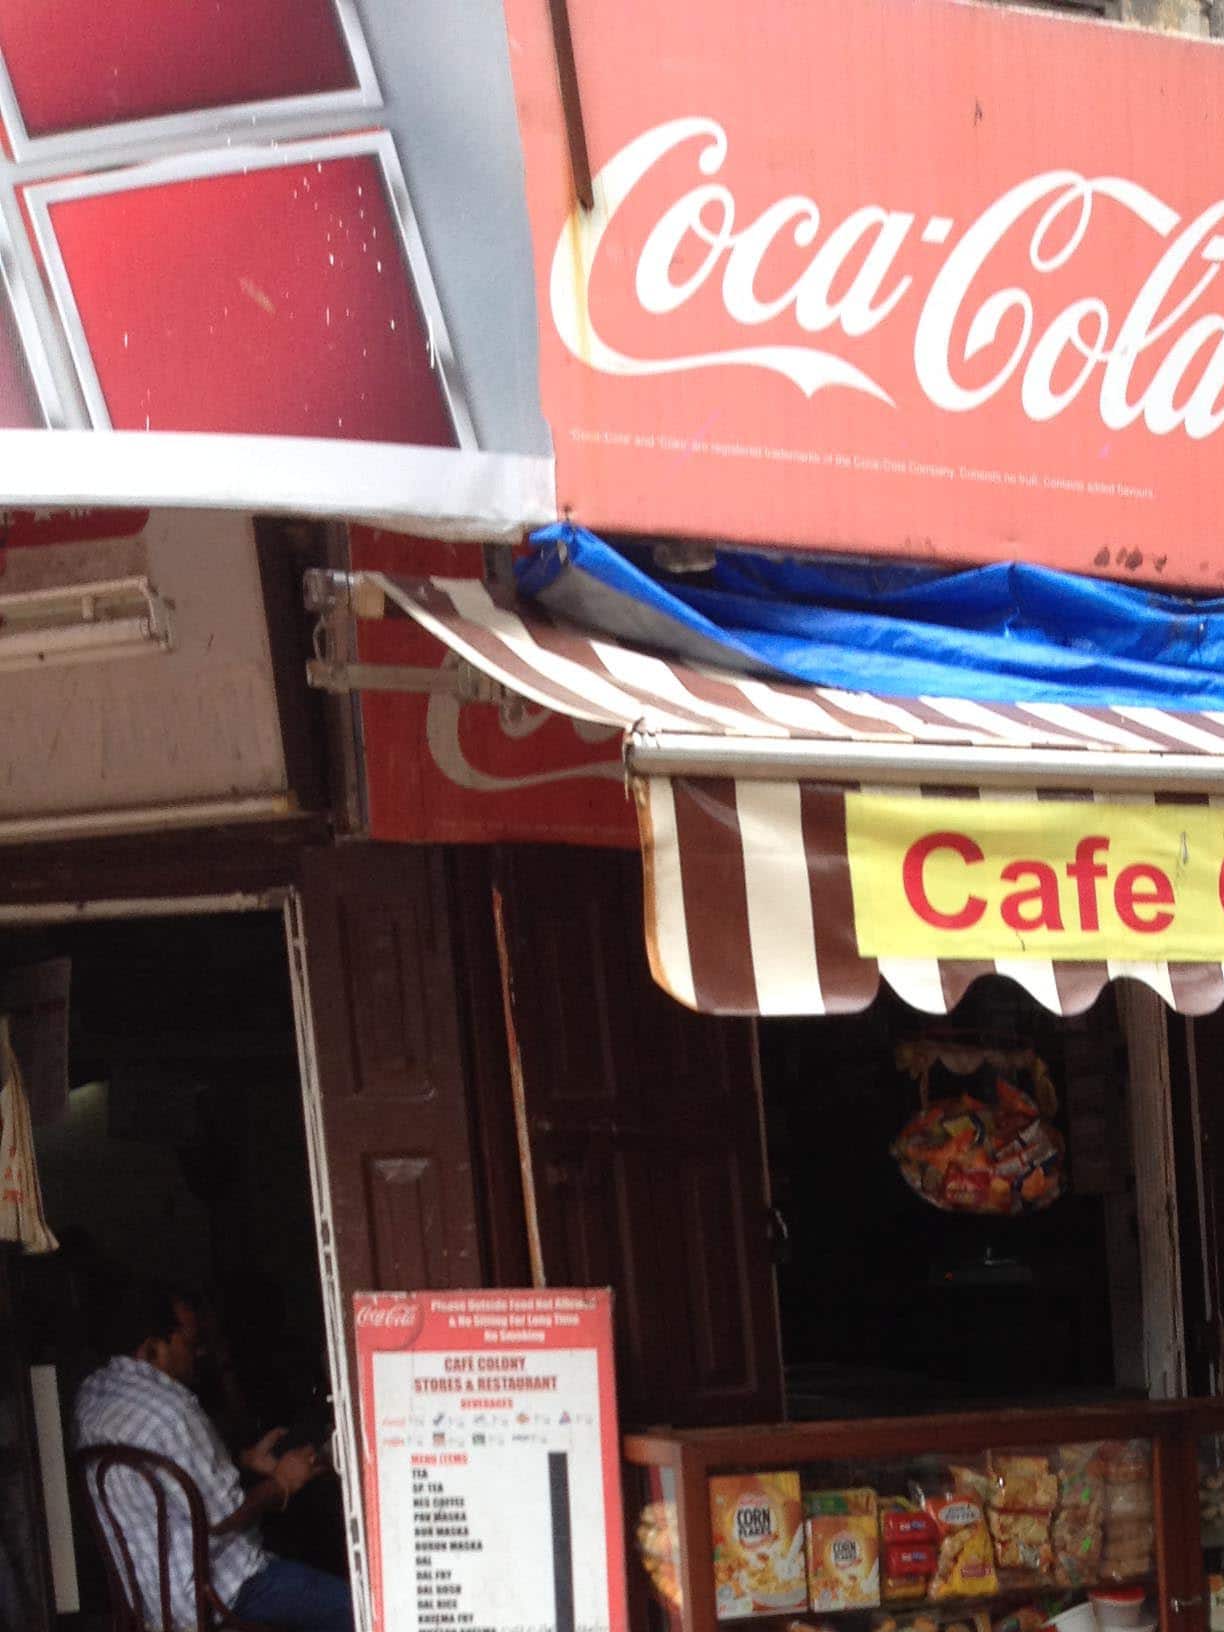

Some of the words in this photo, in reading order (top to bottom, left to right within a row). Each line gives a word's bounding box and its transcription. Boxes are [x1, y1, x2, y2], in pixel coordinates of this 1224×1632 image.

[901, 830, 1176, 934] Cafe
[477, 1356, 526, 1372] COLONY
[414, 1378, 463, 1394] STORES
[477, 1375, 558, 1393] RESTAURANT
[737, 1507, 771, 1530] CORN
